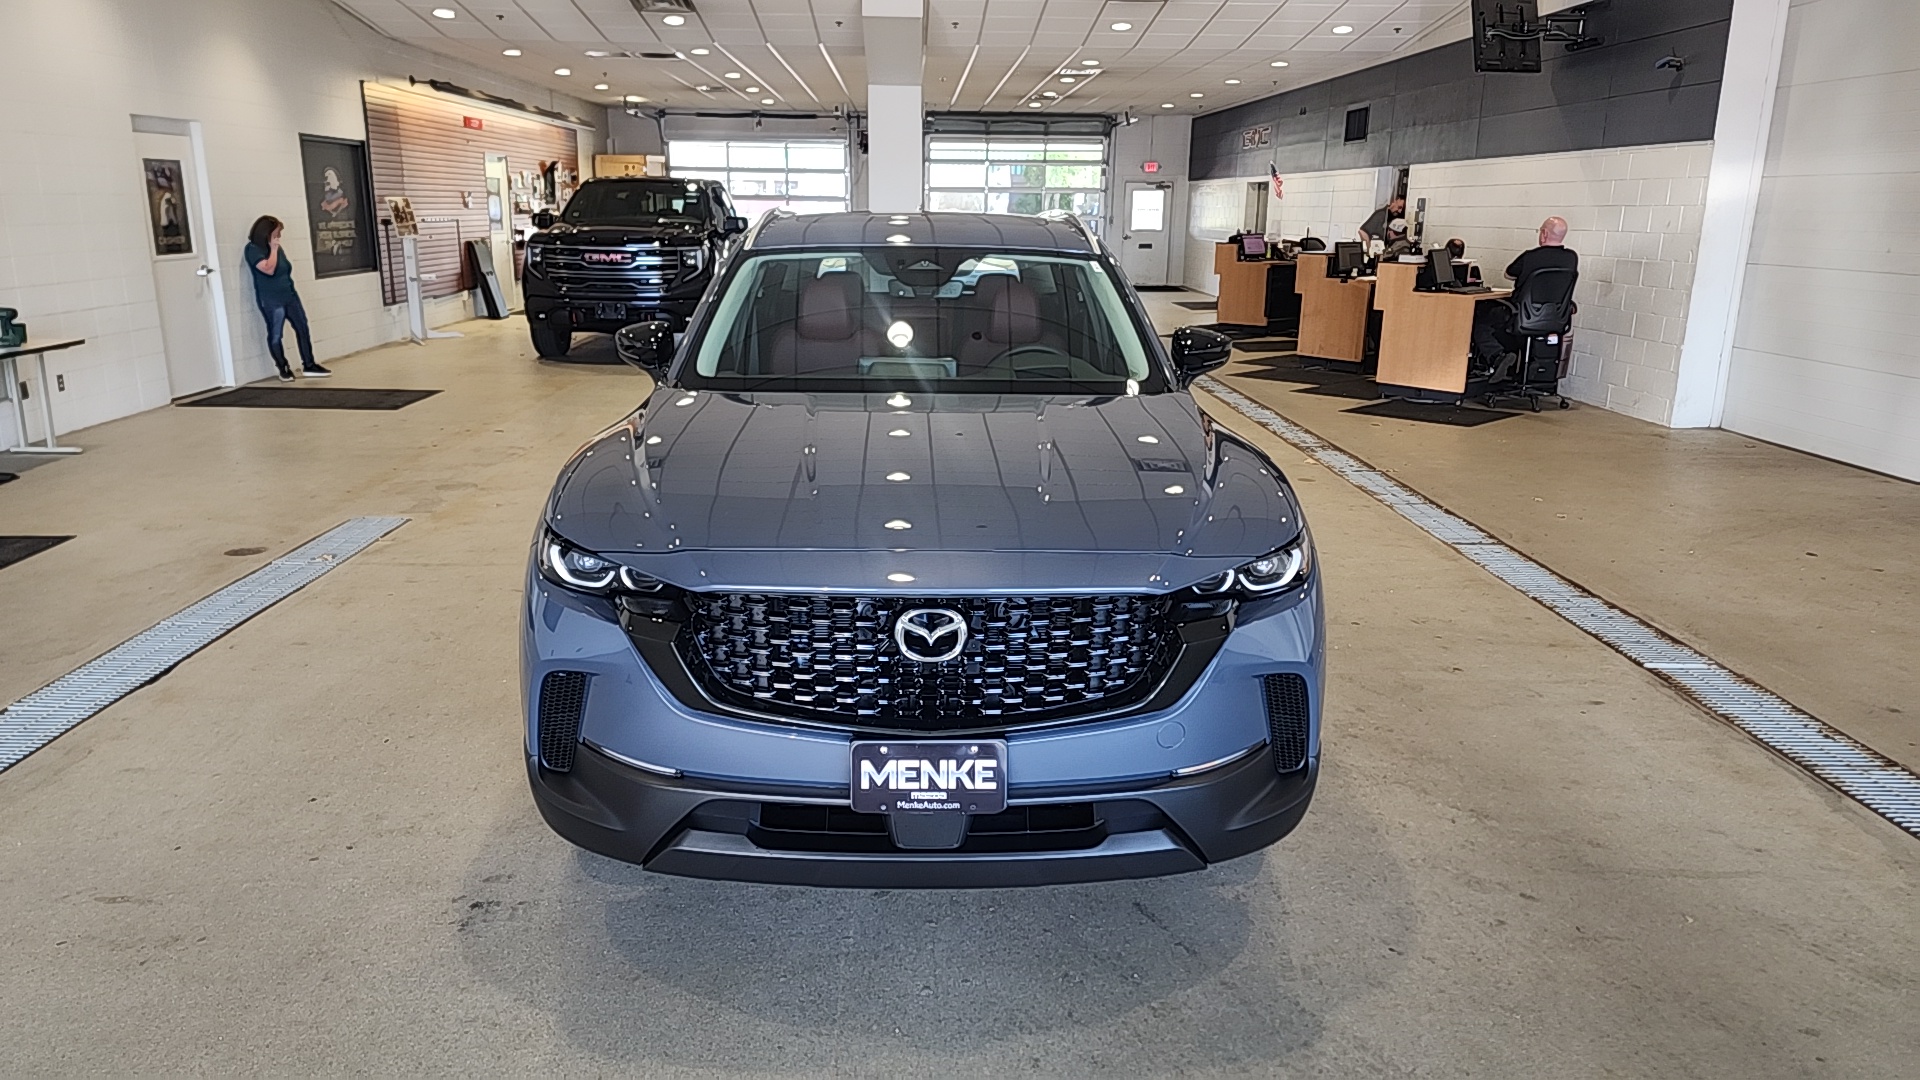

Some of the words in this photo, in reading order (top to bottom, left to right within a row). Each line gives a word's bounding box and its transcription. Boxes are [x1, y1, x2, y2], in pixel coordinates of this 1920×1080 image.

[583, 252, 632, 263] GMC
[860, 759, 997, 790] MENKE
[896, 800, 961, 809] MenkeAuto.com
